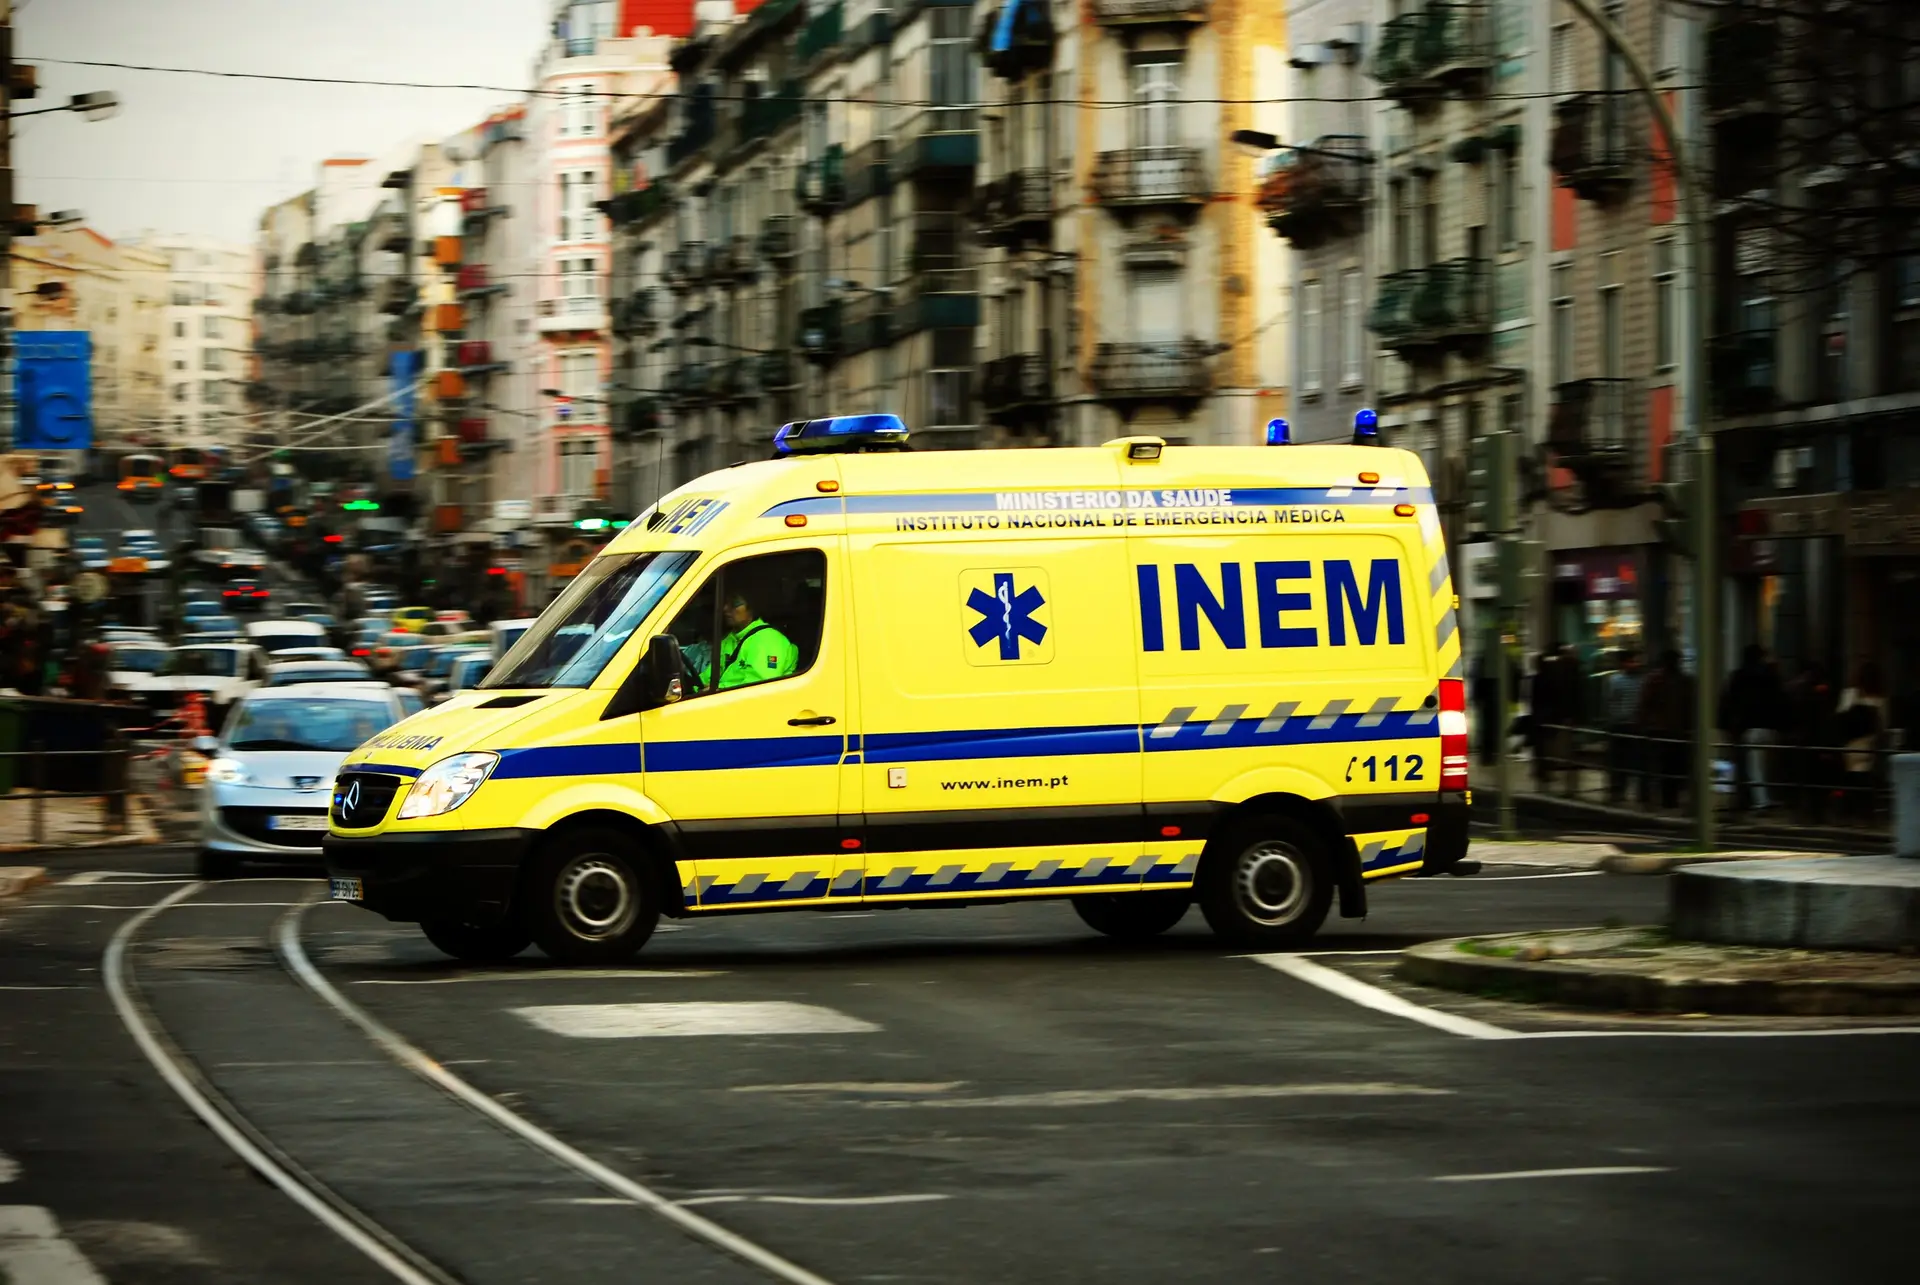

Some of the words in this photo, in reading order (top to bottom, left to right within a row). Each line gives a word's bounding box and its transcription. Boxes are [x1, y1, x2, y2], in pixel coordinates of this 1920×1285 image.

[1127, 490, 1157, 507] DA
[648, 498, 731, 537] INEM
[895, 514, 1000, 532] INSTITUTO
[1007, 511, 1106, 529] NACIONAL
[1112, 511, 1137, 527] DE
[1144, 507, 1268, 526] EMERGÊNCIA
[1274, 505, 1345, 523] MÉDICA
[1137, 559, 1405, 652] INEM
[1362, 754, 1424, 782] 112
[941, 774, 1069, 790] www.inem.pt
